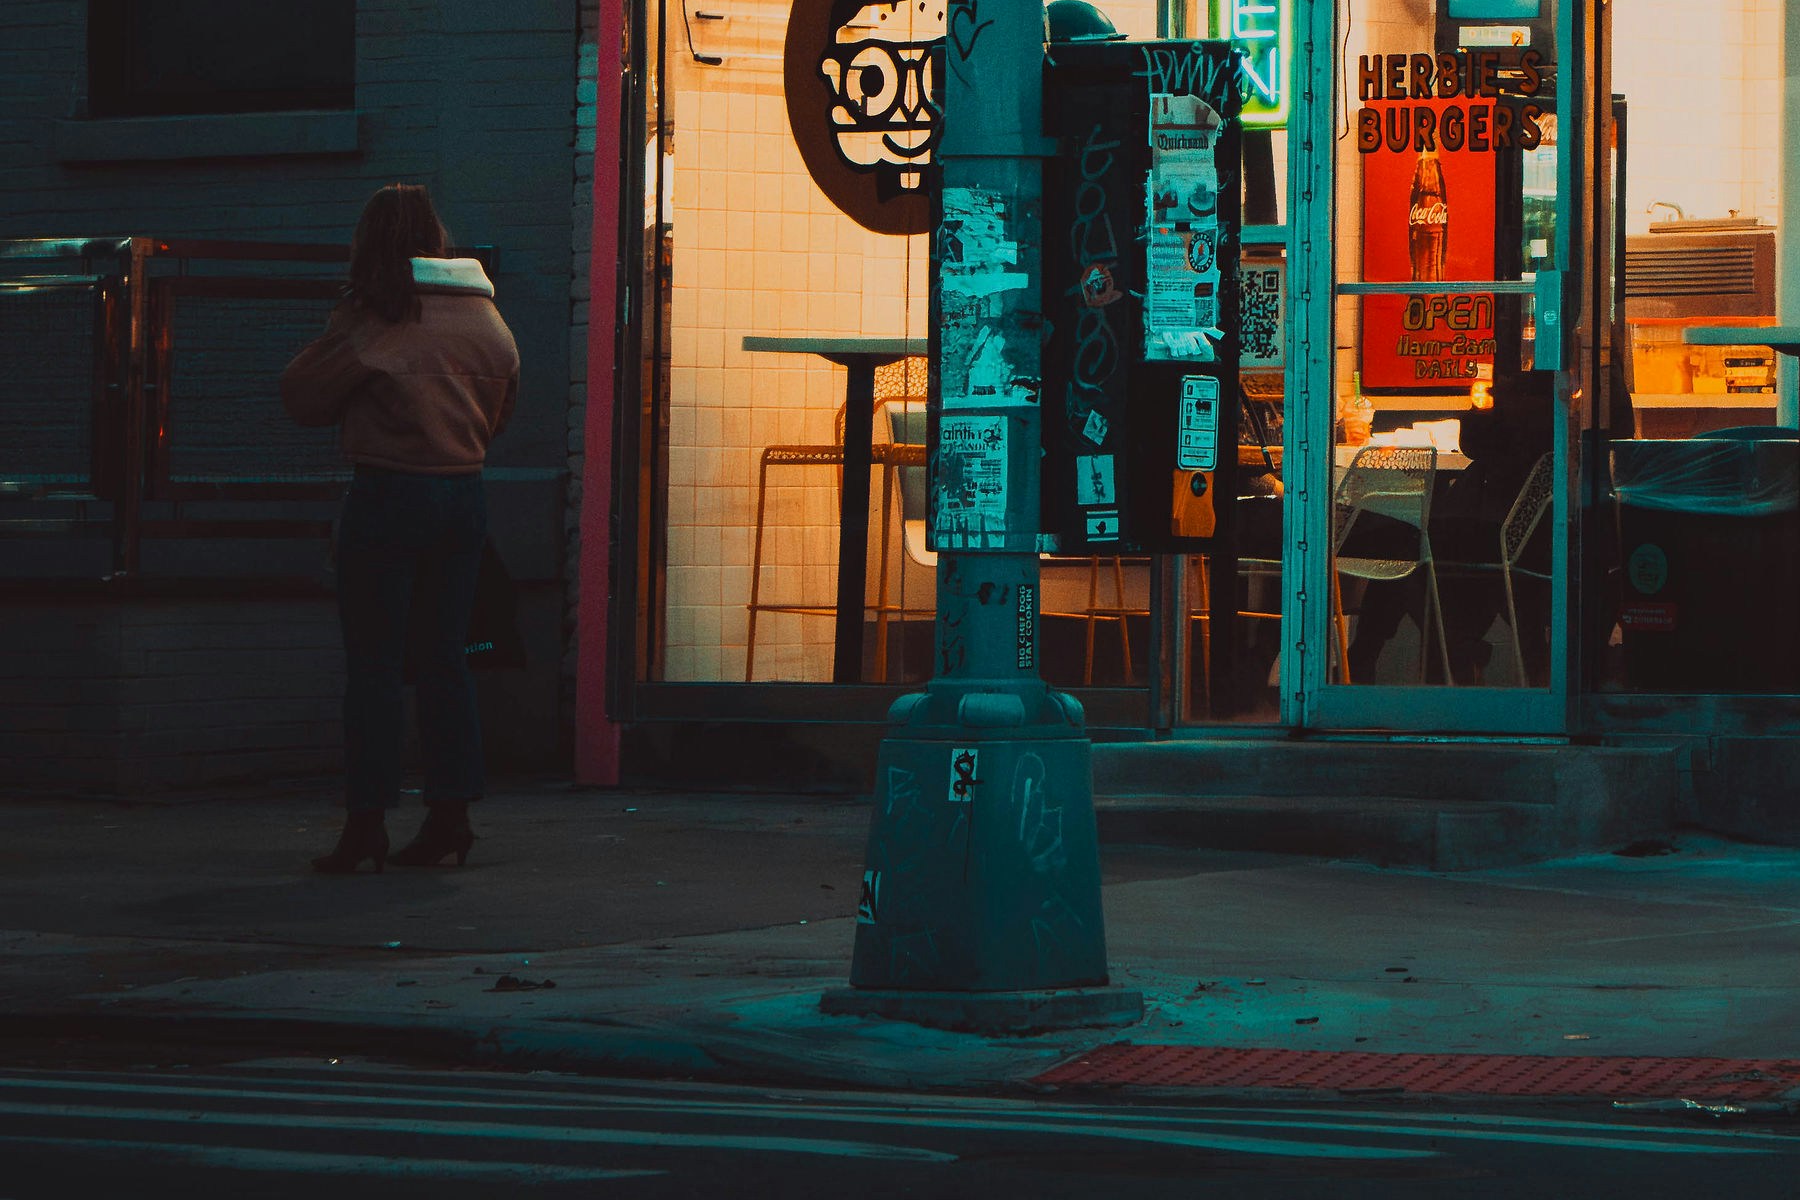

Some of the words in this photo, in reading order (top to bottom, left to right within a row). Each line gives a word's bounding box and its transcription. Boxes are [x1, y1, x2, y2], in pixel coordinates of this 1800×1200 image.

[1357, 103, 1544, 154] BURGERS
[1402, 295, 1494, 331] OPEN
[1414, 358, 1480, 380] DAILY
[1018, 584, 1026, 613] DOG
[1025, 588, 1033, 636] COOKIN
[1025, 641, 1033, 668] STAY
